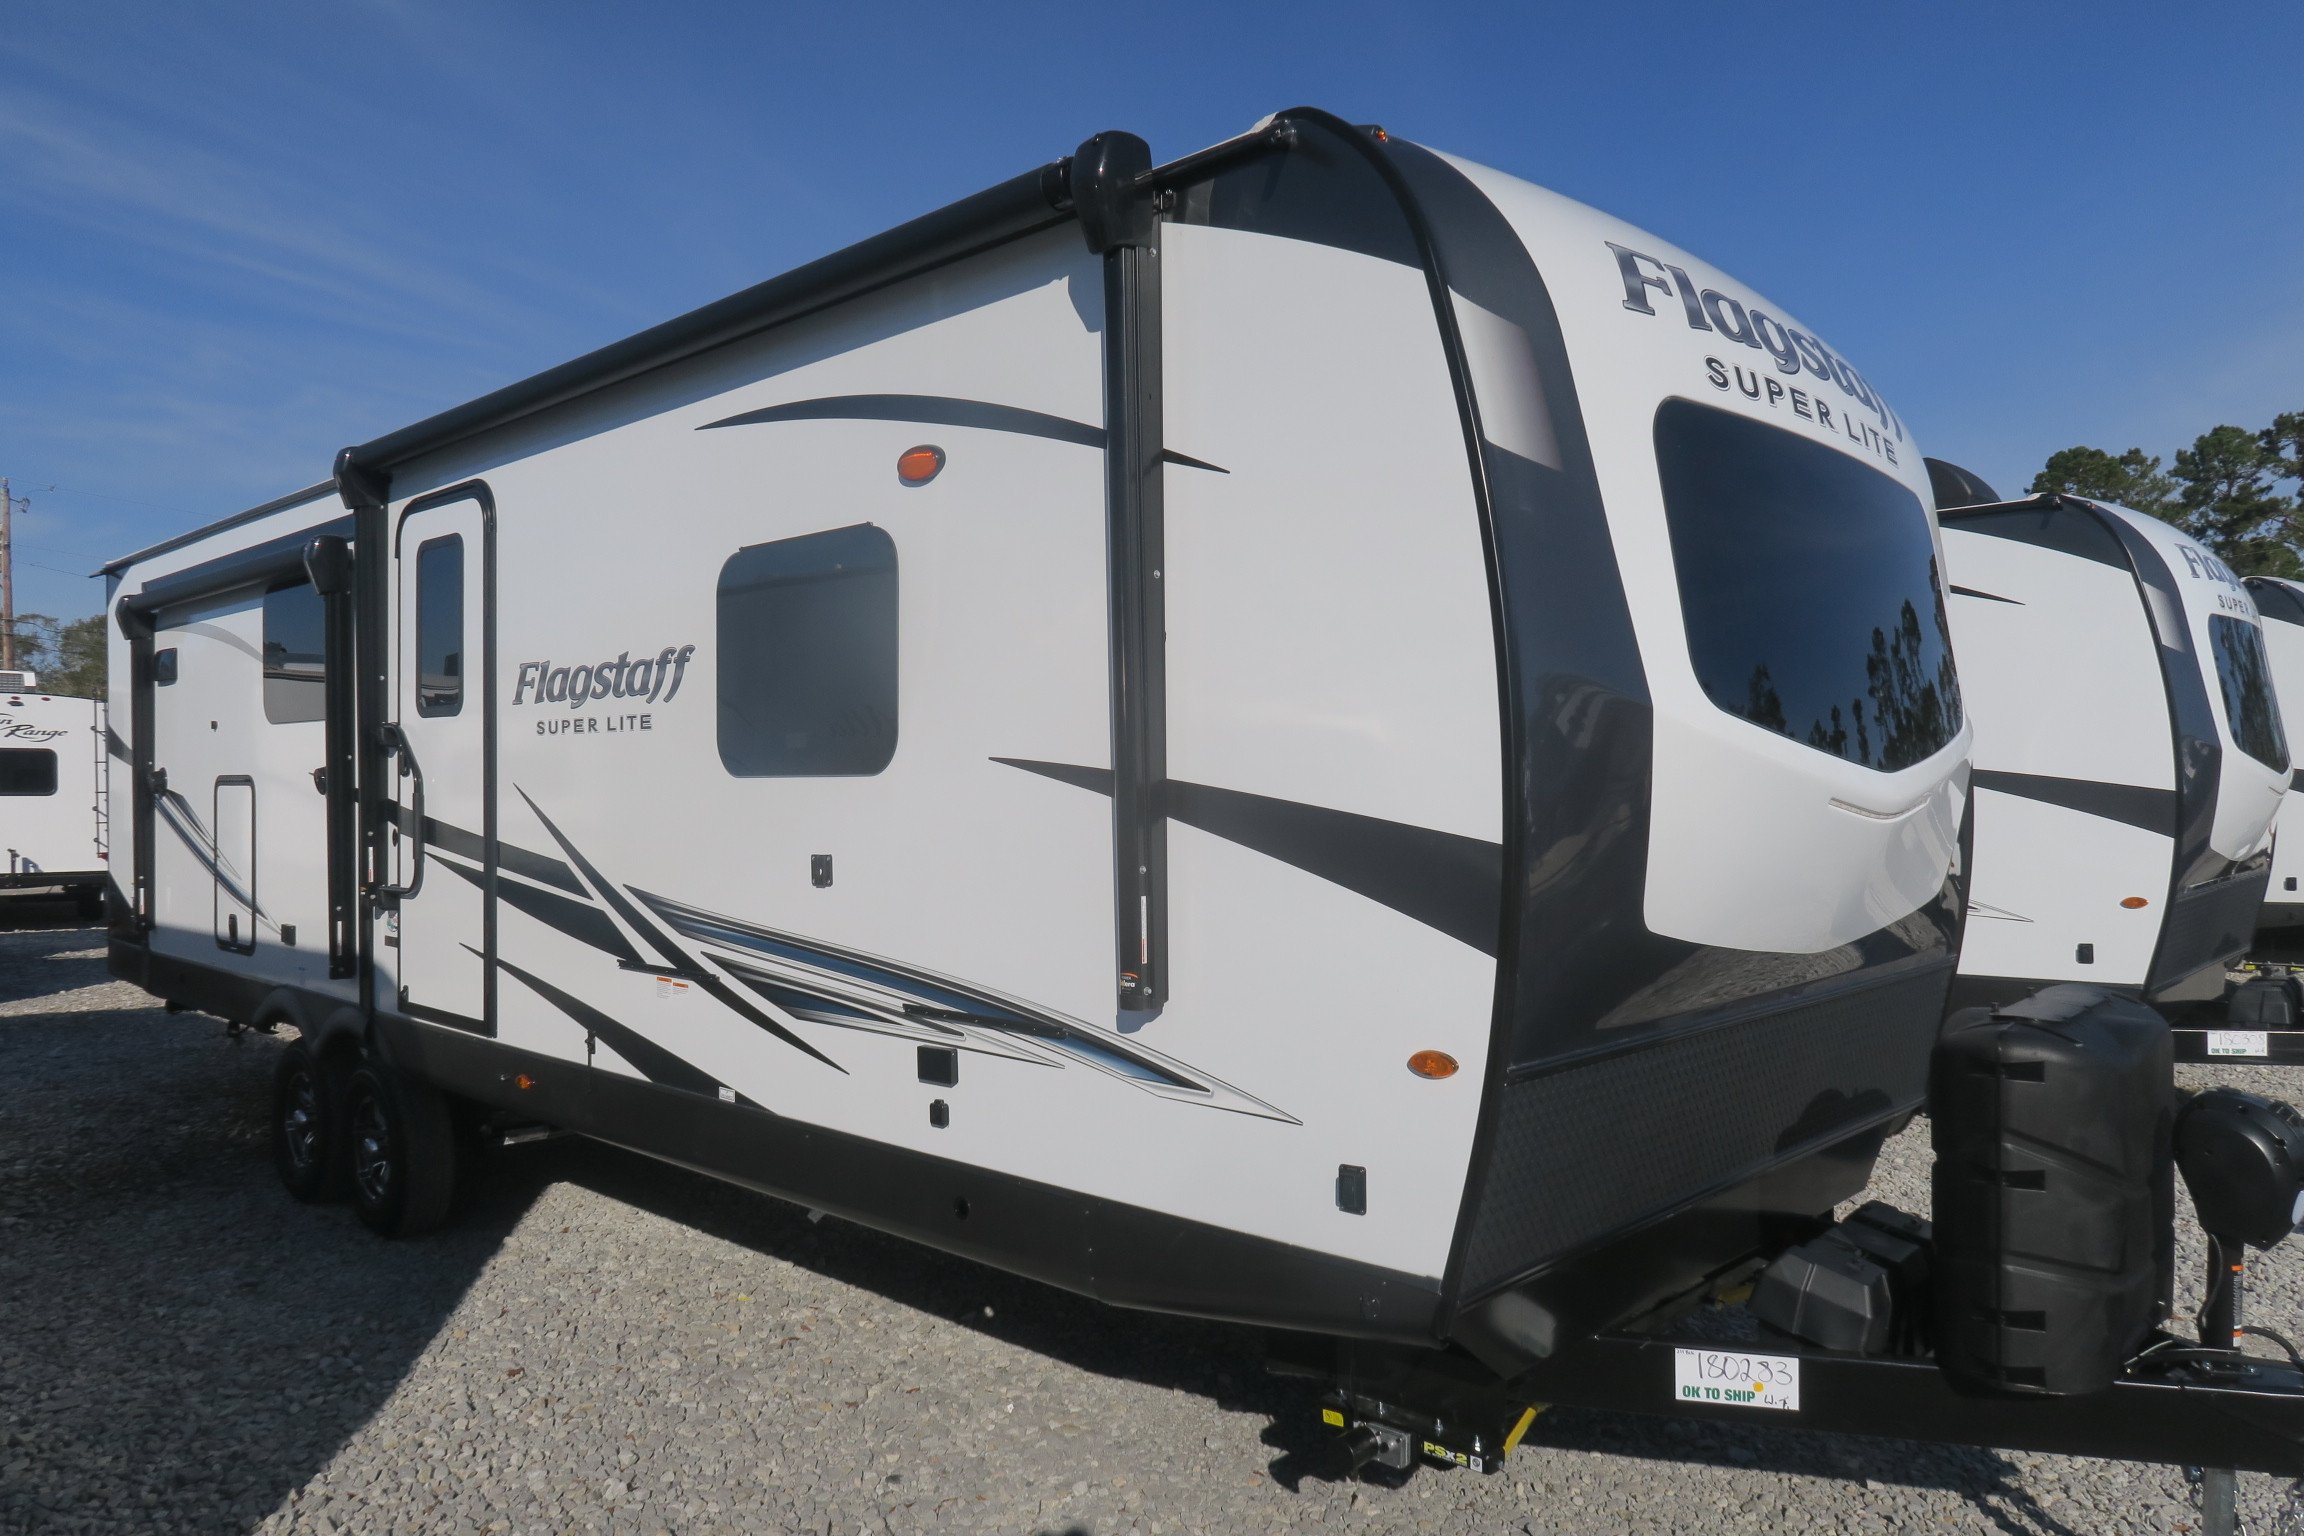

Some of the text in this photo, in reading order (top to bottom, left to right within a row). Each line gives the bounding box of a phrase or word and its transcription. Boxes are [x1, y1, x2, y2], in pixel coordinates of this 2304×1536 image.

[1705, 355, 1899, 469] SUPER LITE
[512, 644, 697, 710] Flagstaff
[0, 724, 69, 742] Range
[536, 713, 653, 735] SUPER LITE
[2231, 1047, 2247, 1055] SHIP
[1682, 1385, 1756, 1403] OK TO SHIP
